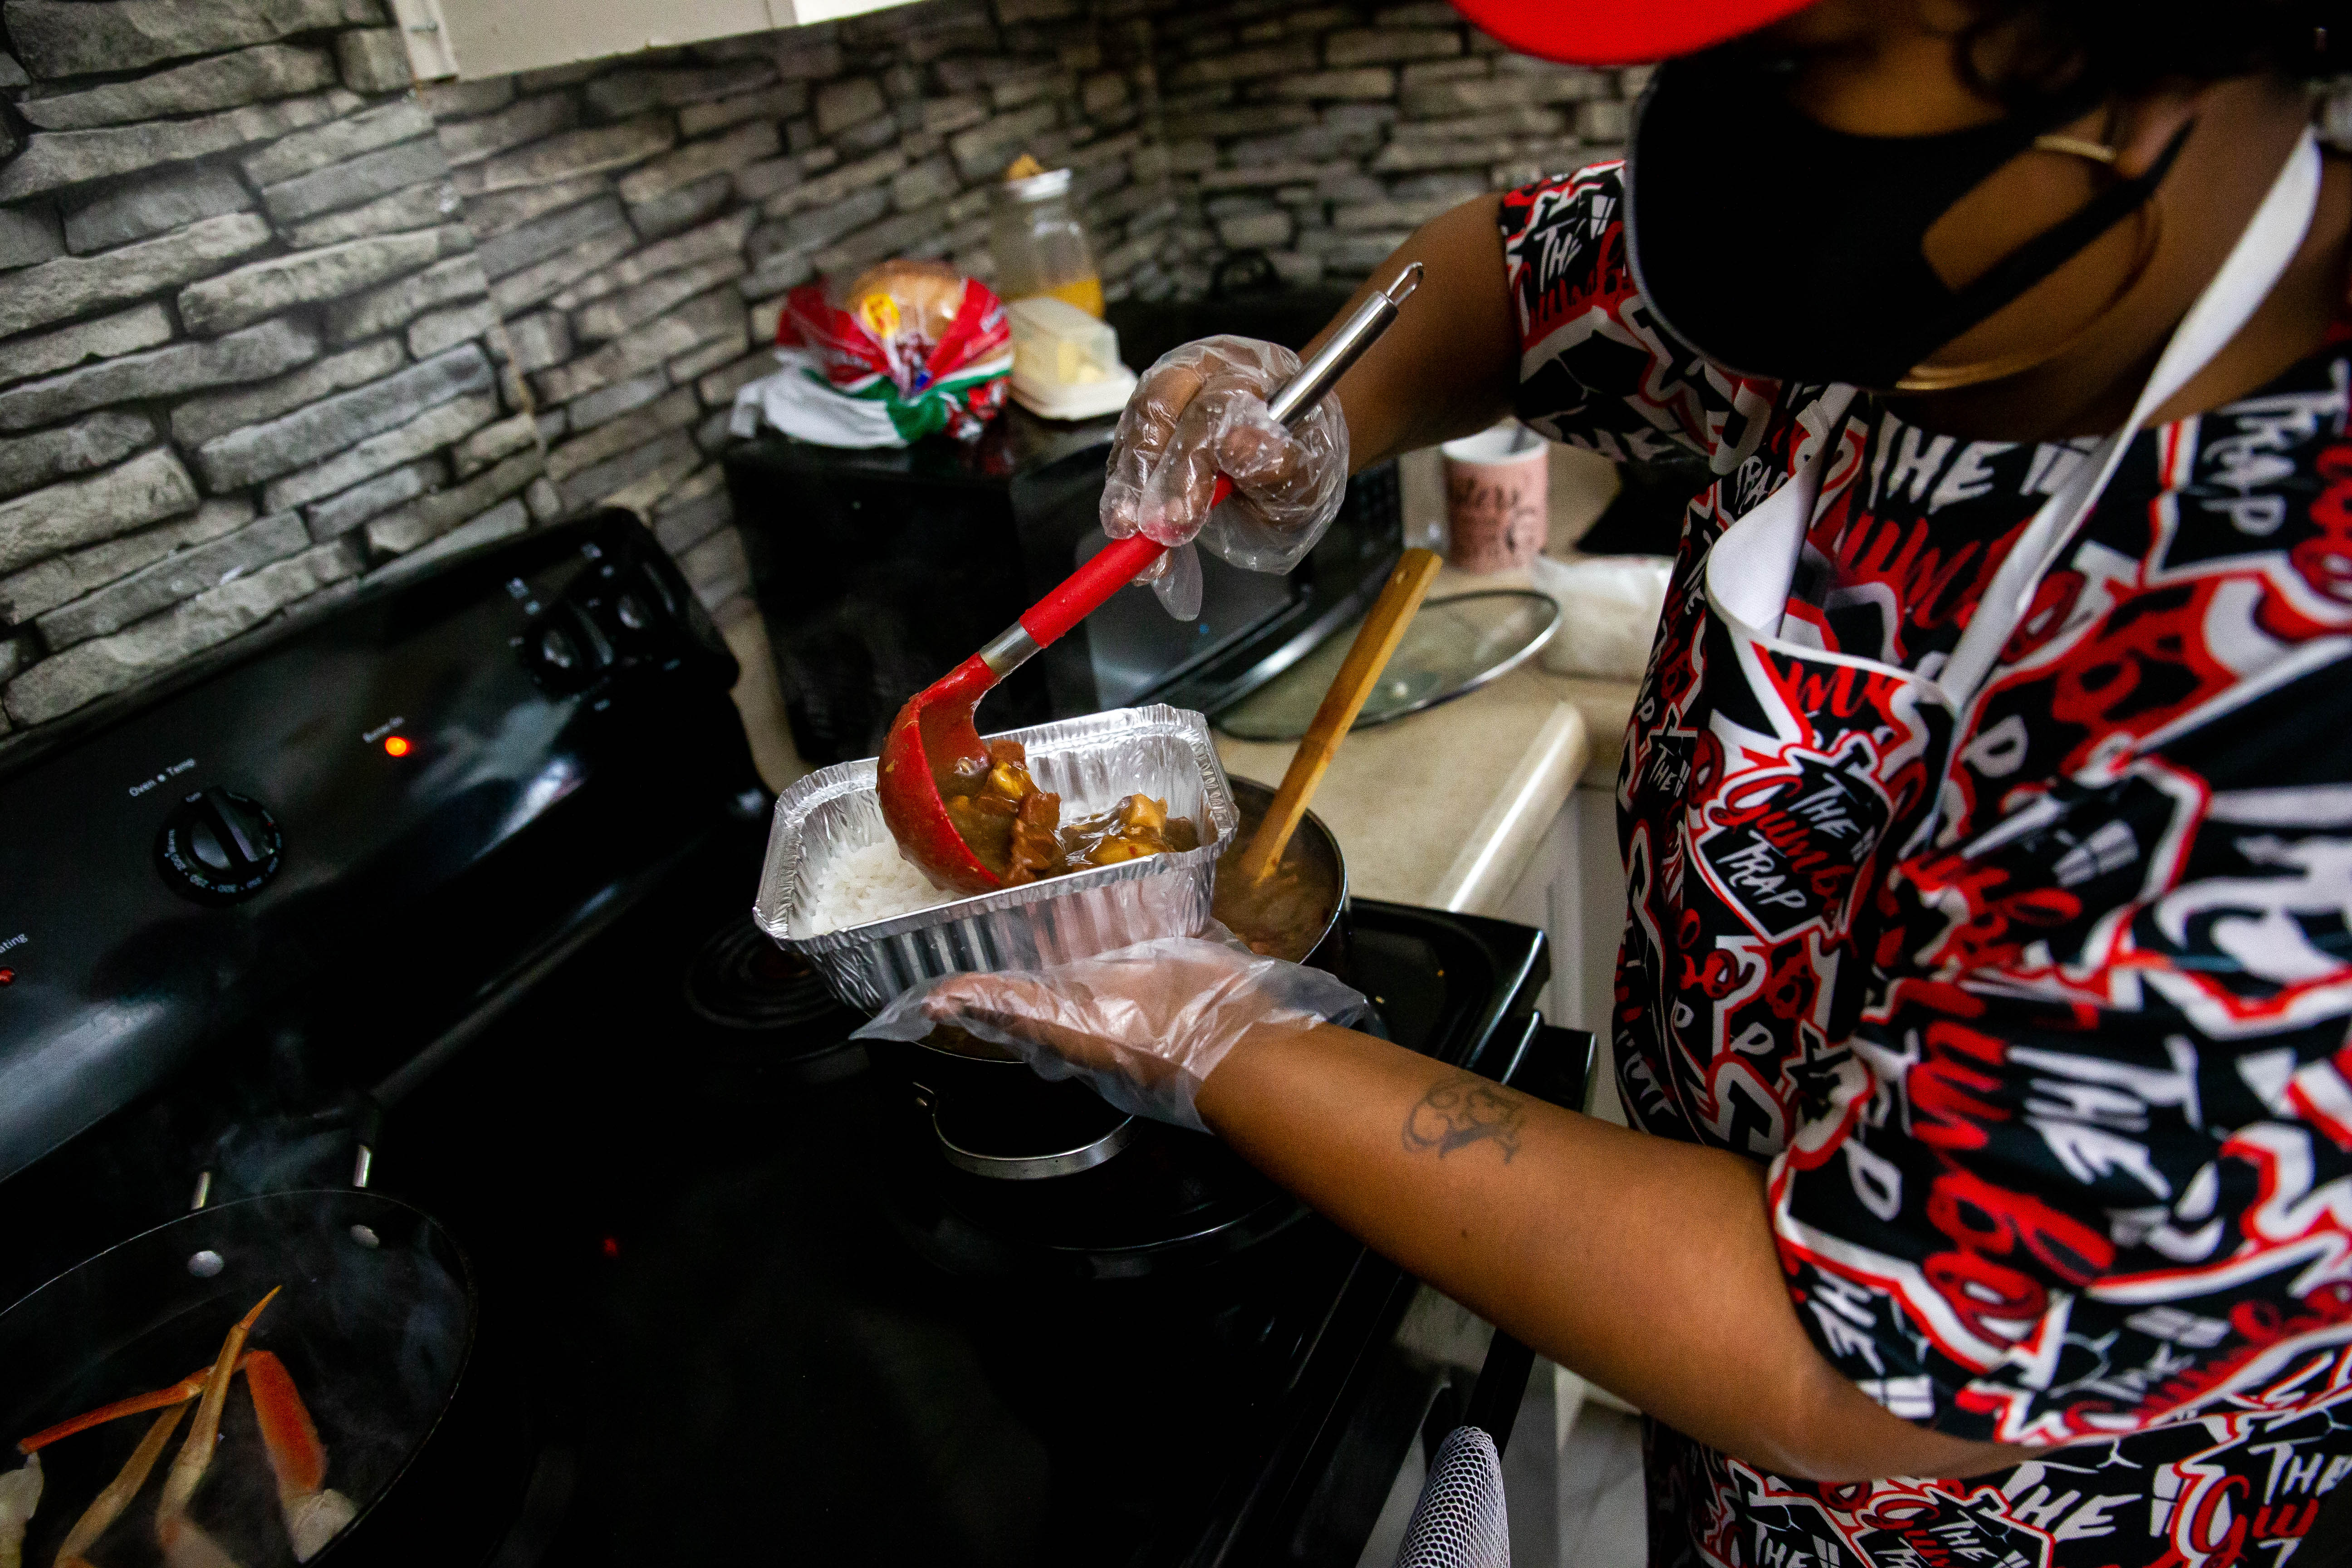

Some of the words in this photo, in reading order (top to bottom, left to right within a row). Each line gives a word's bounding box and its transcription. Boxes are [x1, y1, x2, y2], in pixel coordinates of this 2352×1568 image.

[1533, 216, 1588, 293] THE
[1648, 743, 1675, 792] THE
[1787, 772, 1870, 839] THE
[1715, 829, 1808, 909] TRAP
[2006, 1033, 2204, 1200] THE
[1928, 1509, 1999, 1562] THE
